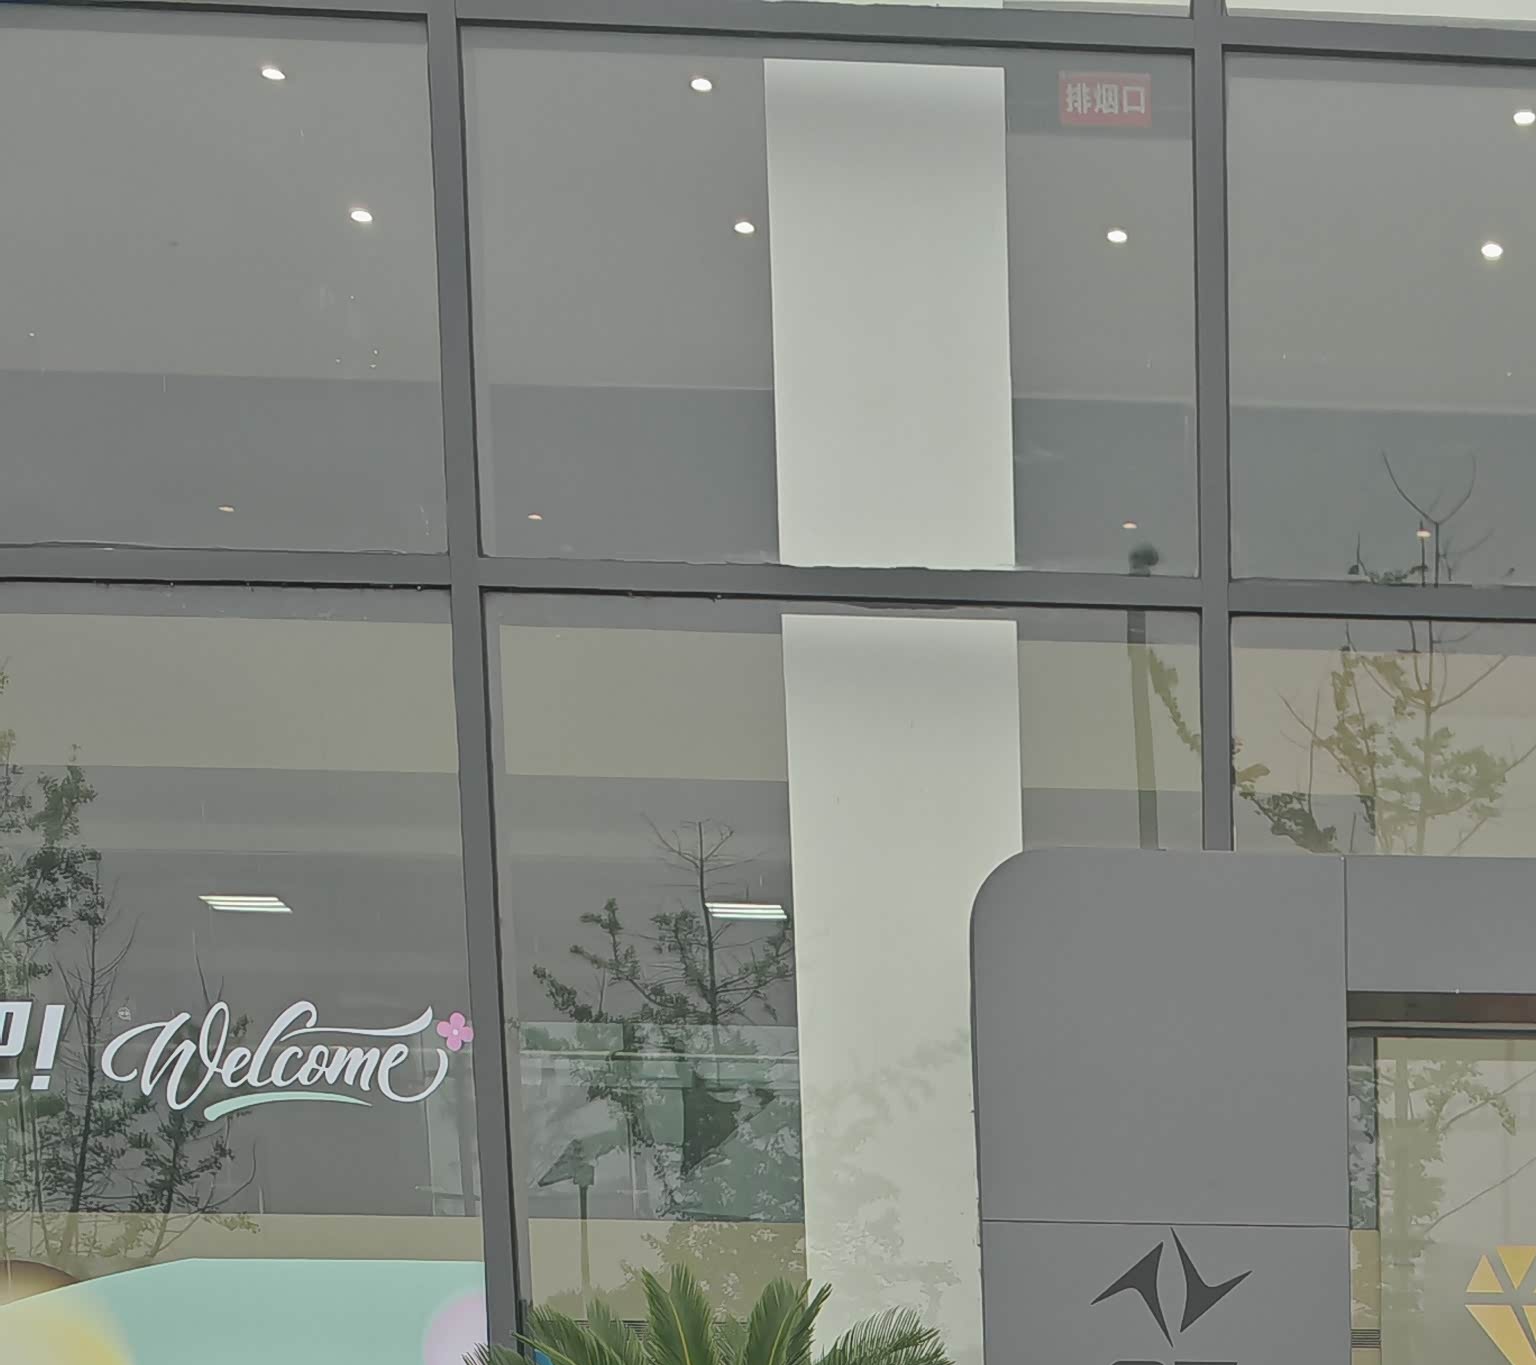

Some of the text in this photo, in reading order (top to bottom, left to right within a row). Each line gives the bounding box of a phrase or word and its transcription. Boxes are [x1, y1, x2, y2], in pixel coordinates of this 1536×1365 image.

[1066, 82, 1145, 114] 排烟口
[101, 1001, 450, 1110] Welcome
